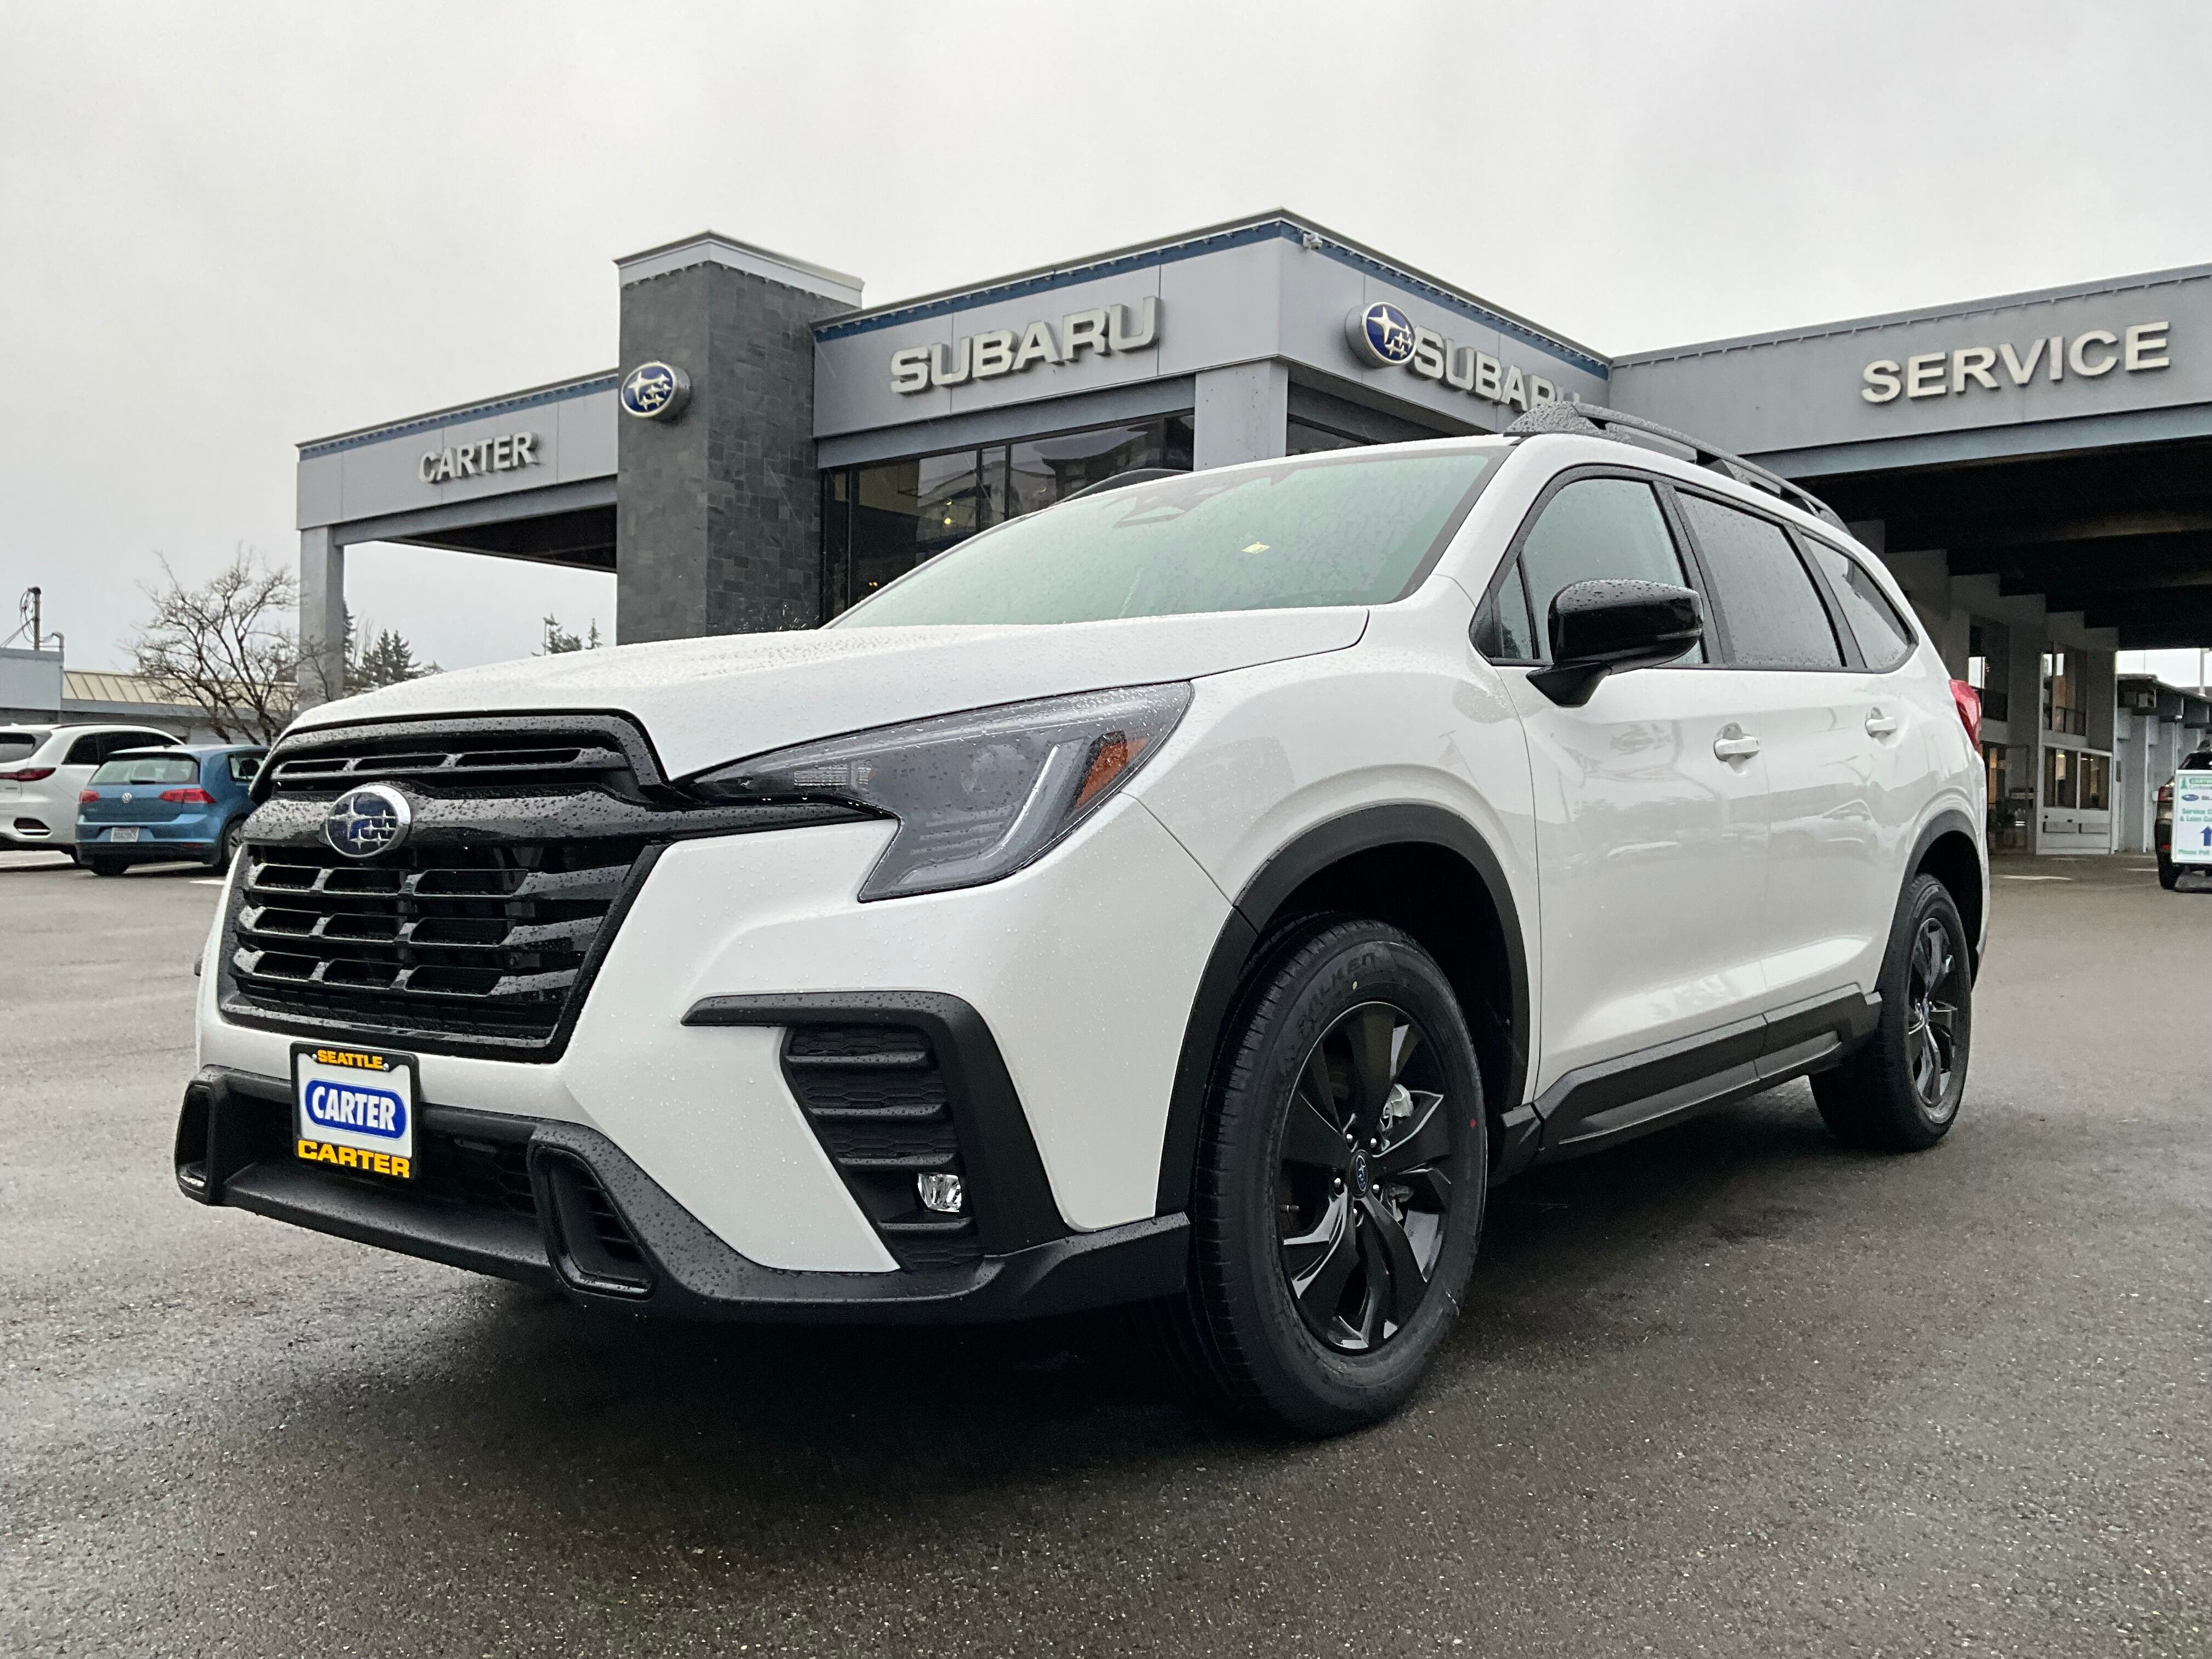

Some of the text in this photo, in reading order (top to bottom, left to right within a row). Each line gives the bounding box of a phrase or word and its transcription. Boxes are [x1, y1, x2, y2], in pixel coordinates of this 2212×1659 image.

[890, 296, 1159, 394] SUBARU
[1861, 320, 2170, 403] SERVICE
[419, 431, 538, 483] CARTER
[317, 1049, 384, 1069] SEATTLE
[311, 1086, 396, 1131] CARTER
[298, 1139, 410, 1179] CARTER
